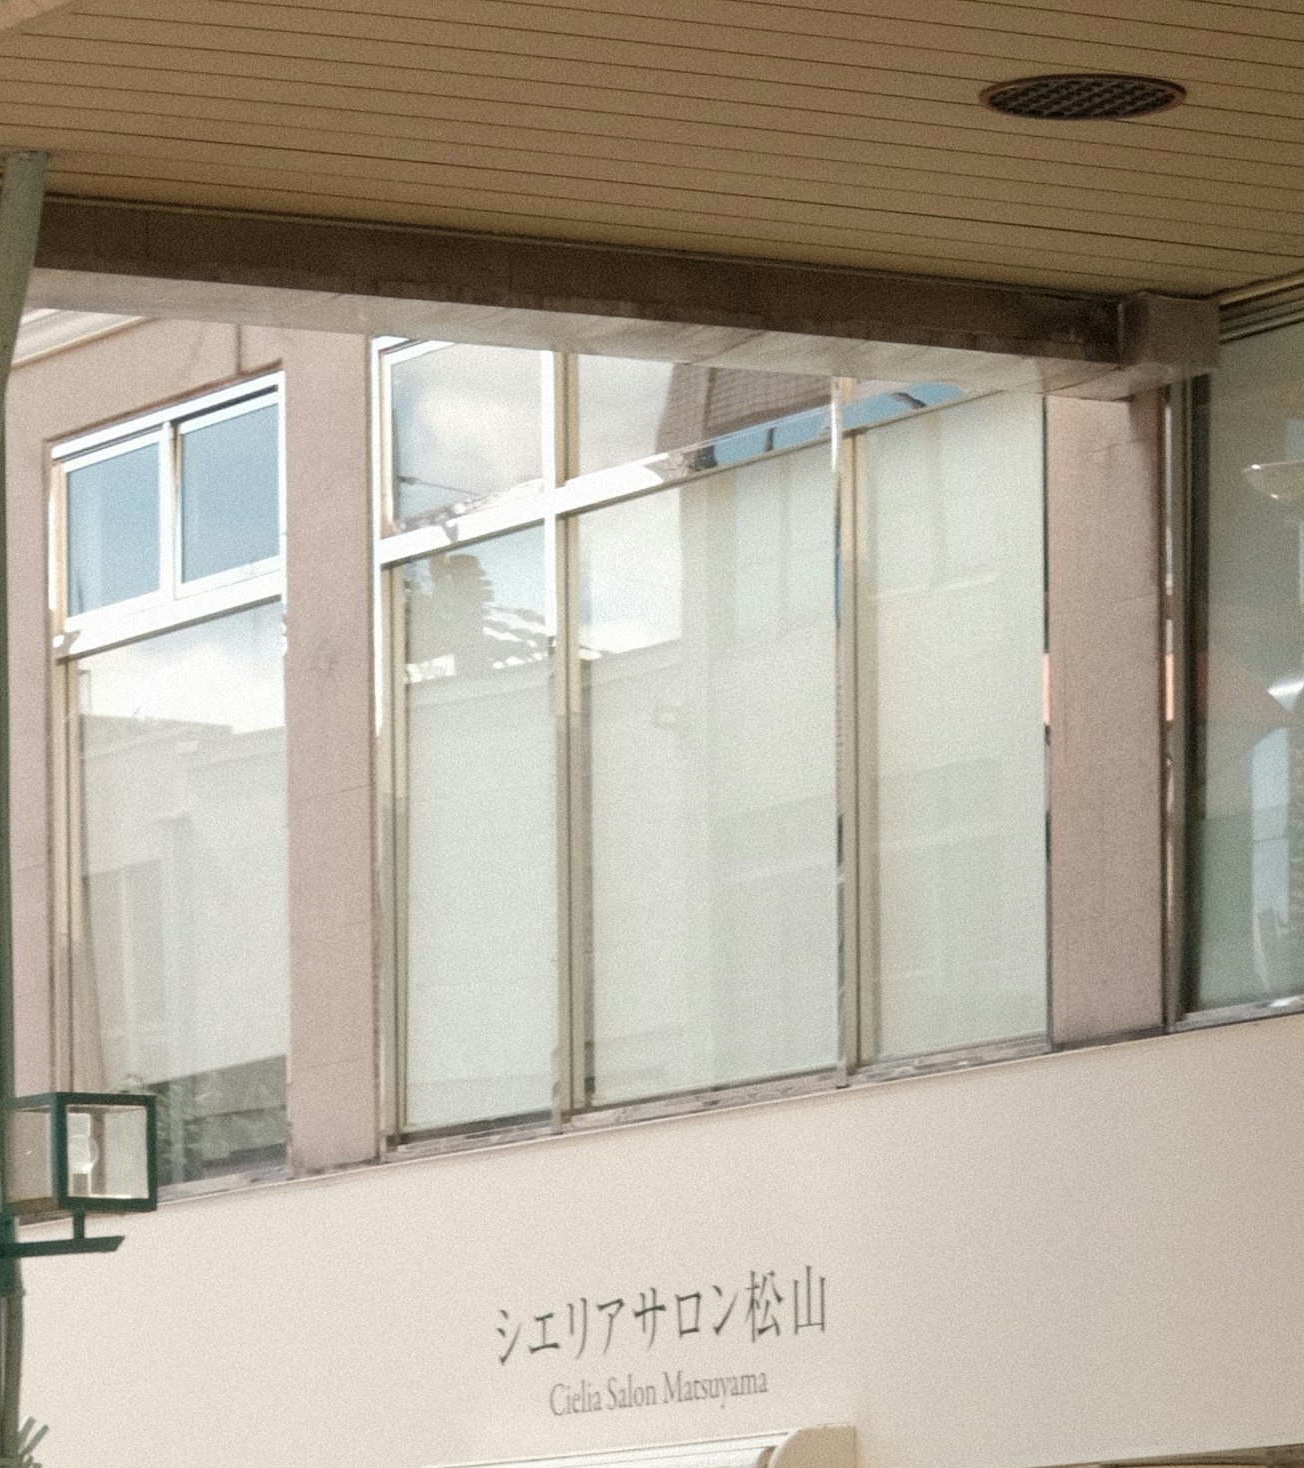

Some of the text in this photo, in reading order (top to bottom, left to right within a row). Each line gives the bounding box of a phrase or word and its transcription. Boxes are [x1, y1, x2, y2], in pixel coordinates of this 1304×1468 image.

[496, 1265, 826, 1365] シエリアサロン松山
[549, 1370, 768, 1416] Cielia Salon Matsuyama
